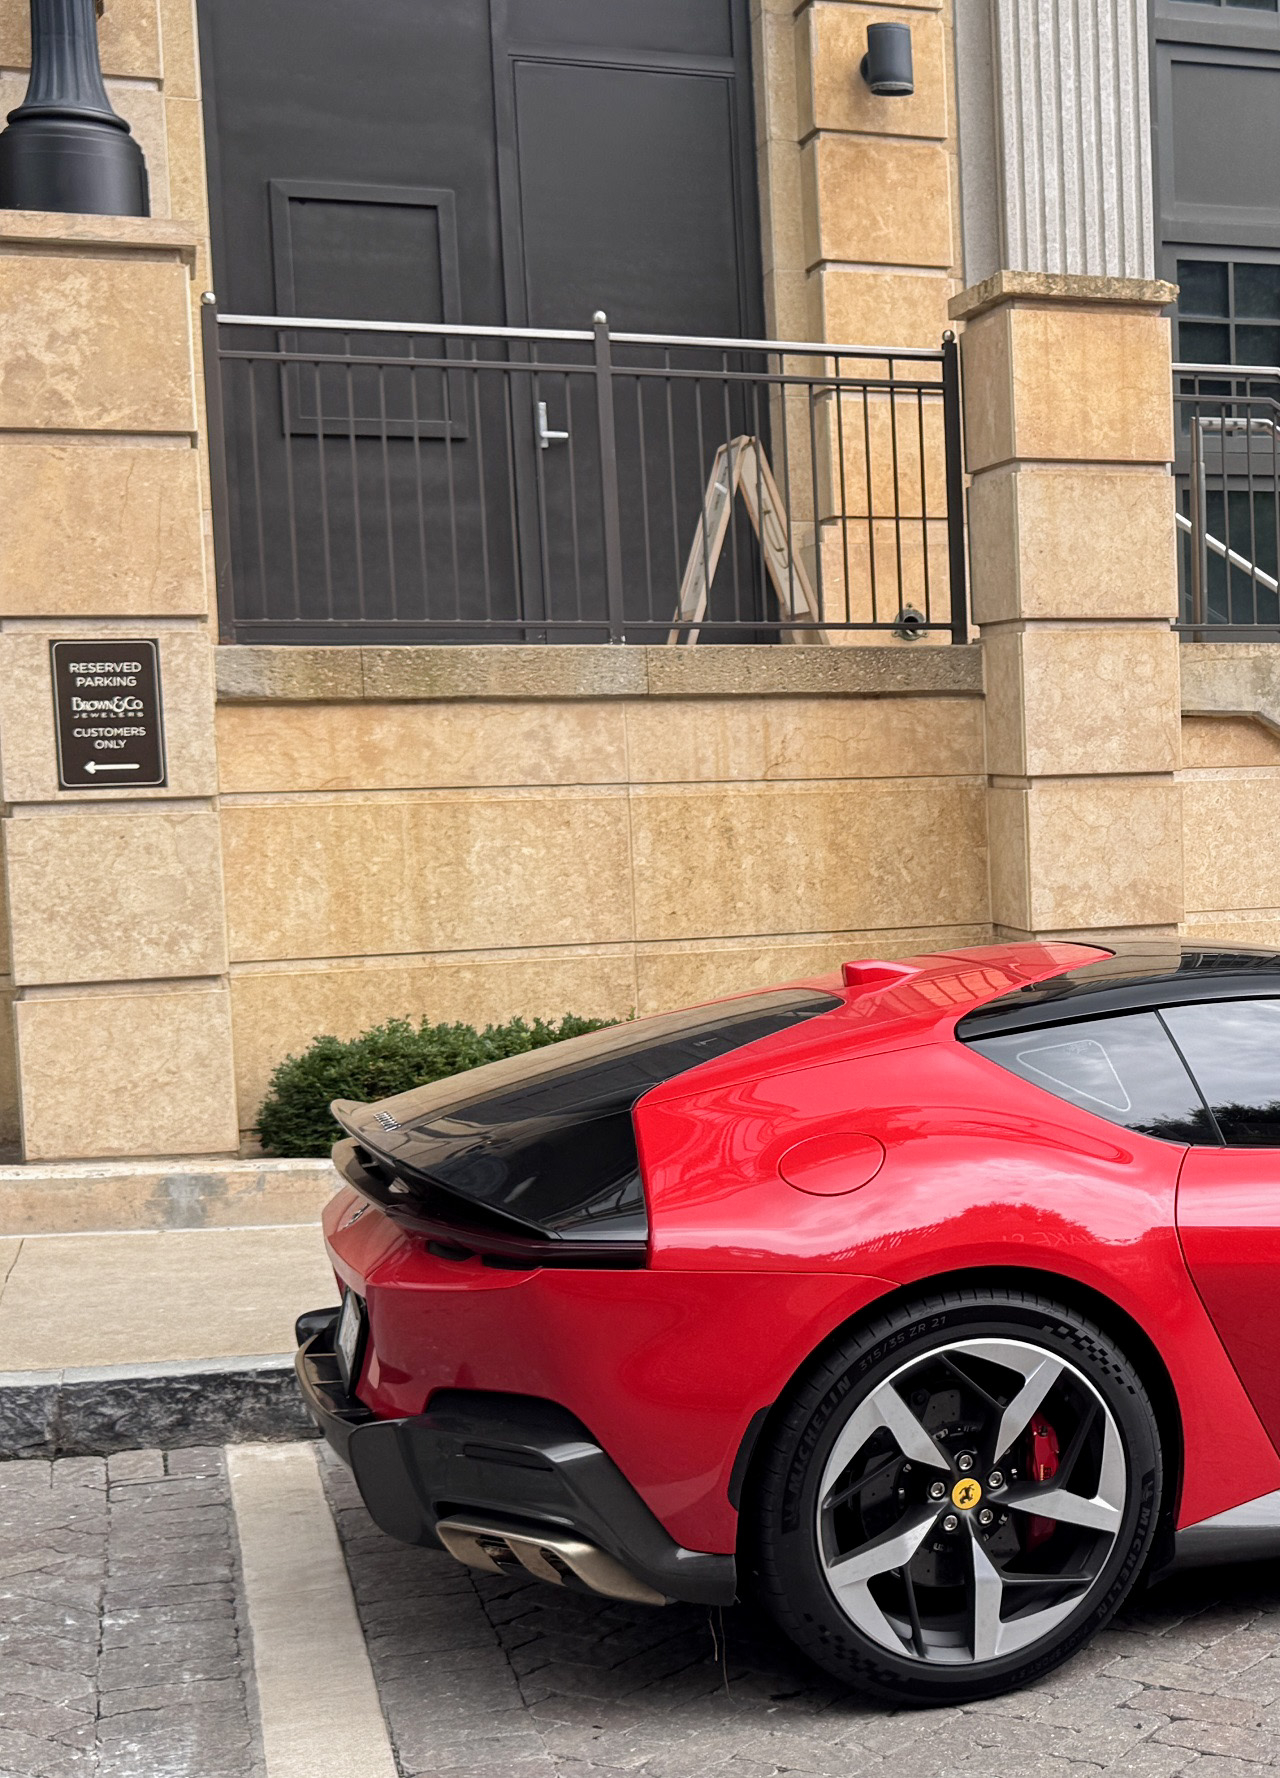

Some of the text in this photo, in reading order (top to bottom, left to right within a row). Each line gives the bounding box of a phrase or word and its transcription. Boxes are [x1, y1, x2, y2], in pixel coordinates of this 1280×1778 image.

[69, 661, 142, 674] RESERVED
[76, 675, 137, 688] PARKING
[74, 711, 144, 719] JEWELERS
[73, 726, 147, 738] CUSTOMERS
[94, 739, 127, 750] ONLY
[857, 1315, 947, 1372] 315/35 ZR 21
[788, 1375, 853, 1494] MICHELIN
[1097, 1507, 1152, 1619] MICHELIN
